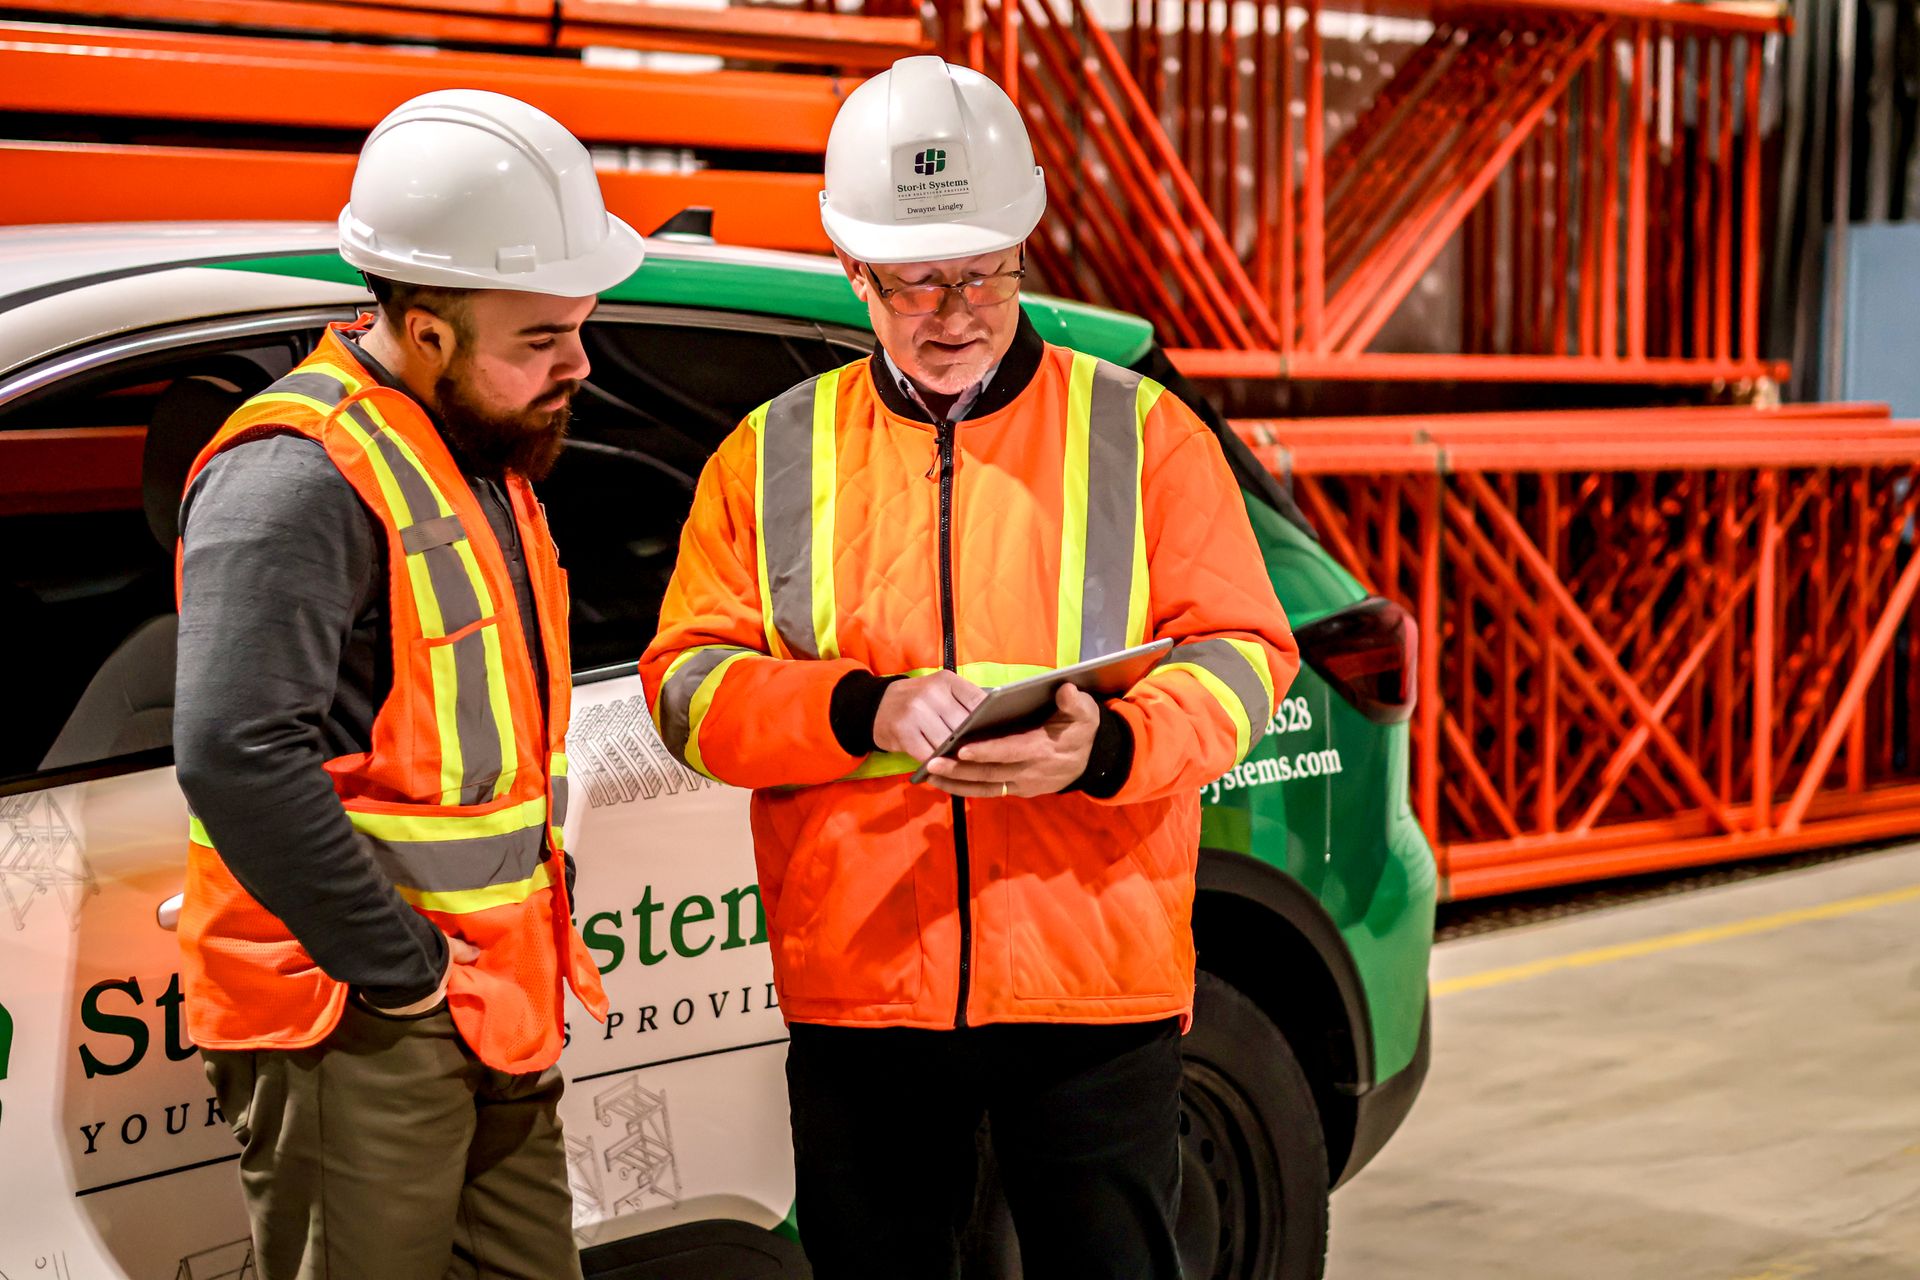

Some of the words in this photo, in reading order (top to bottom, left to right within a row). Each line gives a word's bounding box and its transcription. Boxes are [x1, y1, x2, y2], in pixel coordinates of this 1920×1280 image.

[897, 182, 926, 193] Stor-it
[929, 179, 969, 191] Systems
[907, 206, 936, 214] Dwayne
[938, 202, 964, 212] Lingley
